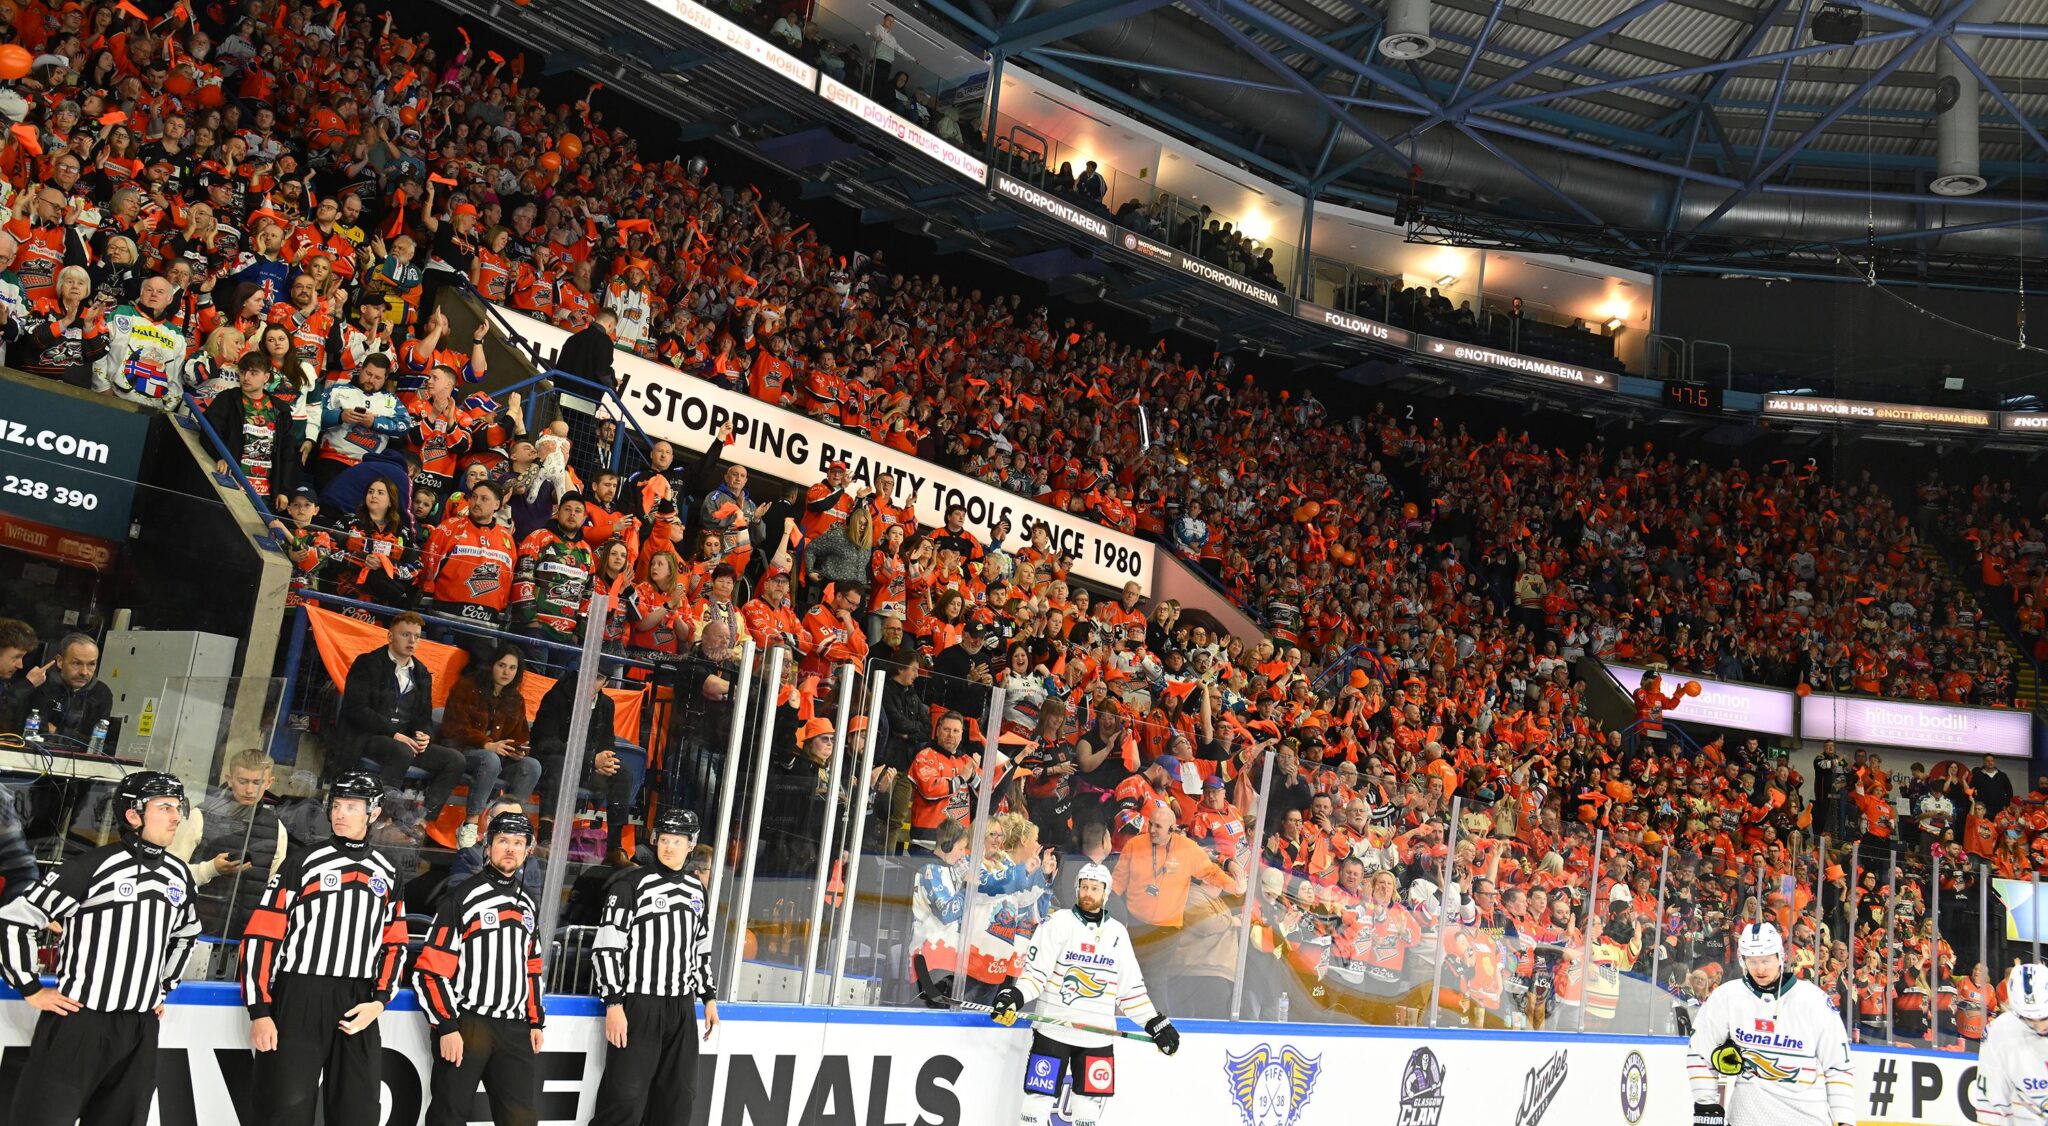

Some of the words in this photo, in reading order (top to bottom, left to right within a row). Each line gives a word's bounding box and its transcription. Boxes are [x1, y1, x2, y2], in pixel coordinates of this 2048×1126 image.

[726, 29, 753, 50] DAB
[765, 51, 808, 81] MOBILE
[826, 81, 859, 110] gem
[863, 103, 906, 140] playing
[908, 130, 939, 154] music
[942, 148, 961, 166] you
[963, 156, 985, 178] love
[999, 177, 1108, 238] MOTORPOINTARENA
[1182, 257, 1279, 306] MOTORPOINTARENA
[1325, 311, 1371, 336] FOLLOW
[1372, 323, 1388, 340] US
[1454, 347, 1584, 382] @NOTTINGHAMARENA
[1671, 387, 1708, 407] 47.6
[1405, 404, 1414, 420] 2
[1768, 399, 1788, 410] TAG
[1790, 401, 1805, 412] US
[1807, 402, 1818, 413] IN
[1820, 403, 1849, 415] YOUR
[1851, 405, 1874, 417] PICS
[1876, 408, 1989, 425] @NOTTINGHAMARENA
[2, 475, 49, 500] 238
[53, 485, 98, 511] 390
[933, 482, 1012, 534] TOOLS
[1020, 513, 1085, 560] SNCE
[1094, 538, 1142, 578] 1980
[1865, 706, 1914, 726] hilton
[1919, 711, 1968, 730] bodill
[1093, 954, 1115, 967] Line
[1735, 1027, 1771, 1046] Stena
[1773, 1031, 1803, 1049] Line
[1027, 1076, 1055, 1090] JANS
[1264, 1067, 1283, 1082] FIFE
[2023, 1077, 2048, 1090] Ste
[699, 1053, 966, 1126] INALS
[1414, 1097, 1443, 1107] GLASGOW
[1399, 1104, 1440, 1126] CLAN
